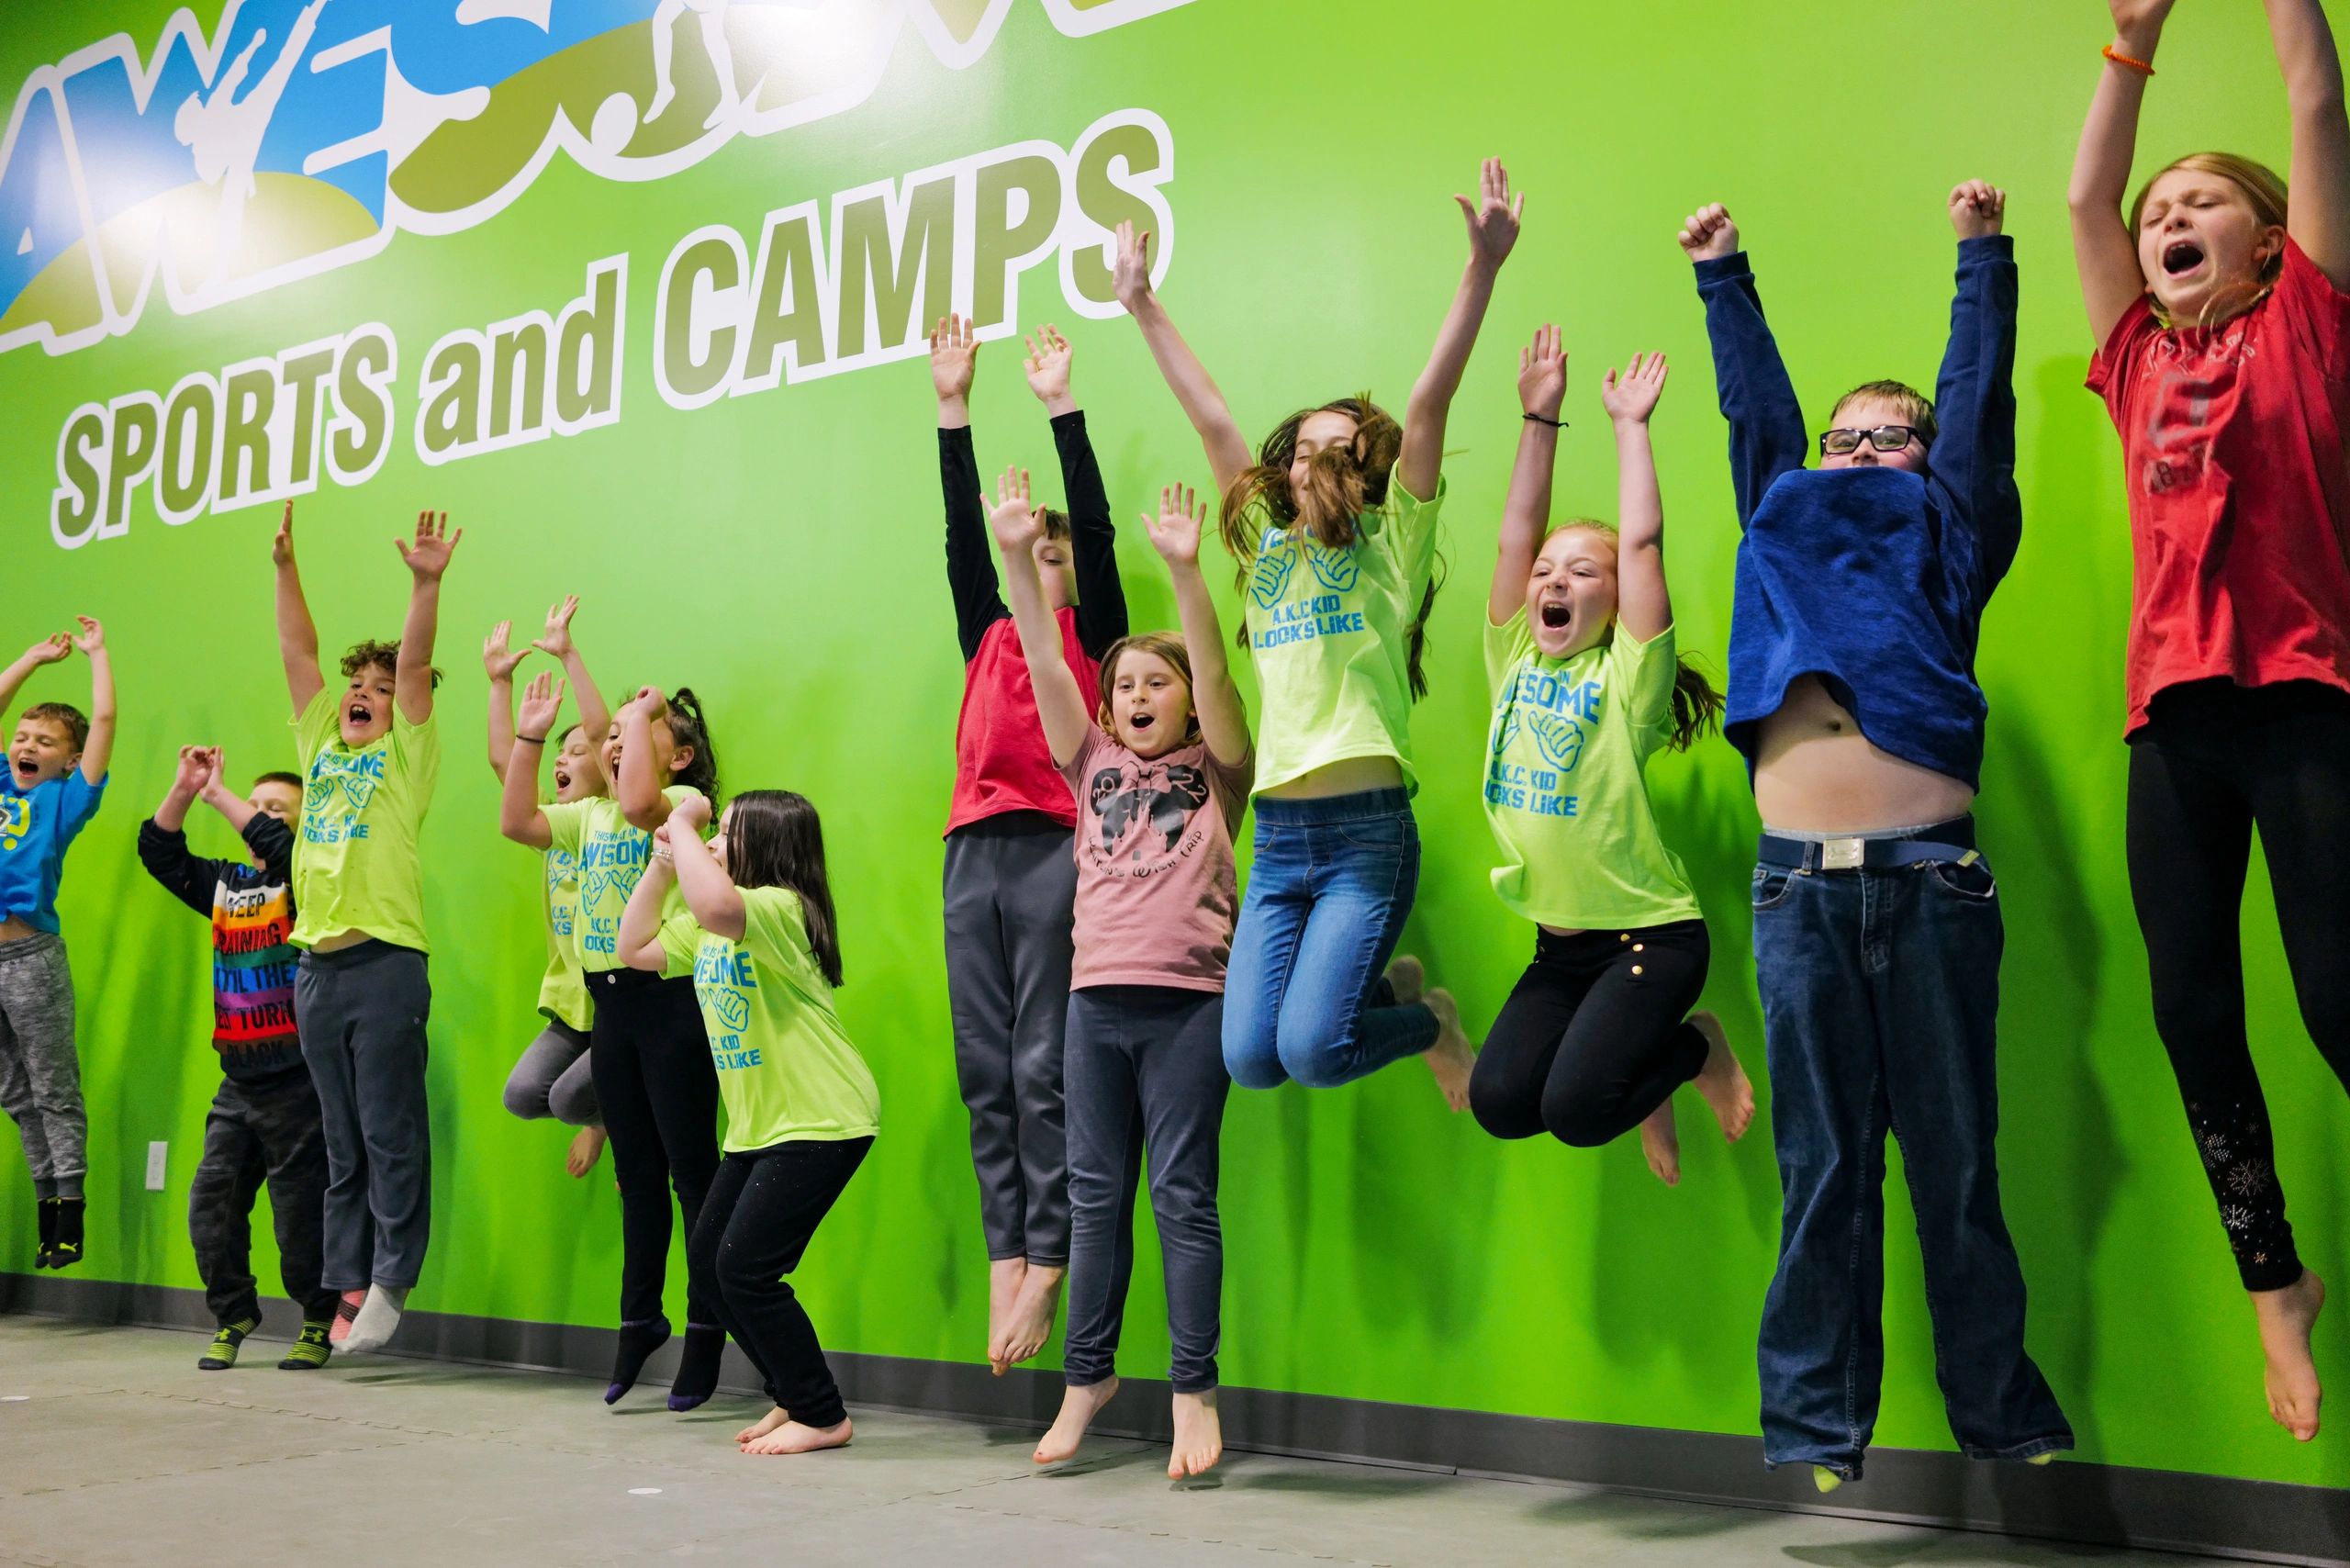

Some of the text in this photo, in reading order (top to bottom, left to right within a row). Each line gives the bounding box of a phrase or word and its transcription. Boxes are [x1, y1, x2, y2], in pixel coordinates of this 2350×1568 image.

[51, 110, 1173, 548] SPORTS and CAMPS
[1311, 595, 1340, 615] KID
[1254, 612, 1365, 649] LOOKS LIKE
[1497, 673, 1603, 724] SOME
[1530, 769, 1557, 791] KID
[1529, 792, 1578, 816] LIKE
[215, 922, 283, 956] RAINING
[236, 998, 296, 1030] TURN
[721, 1034, 741, 1051] KID
[727, 1048, 764, 1070] LIKE
